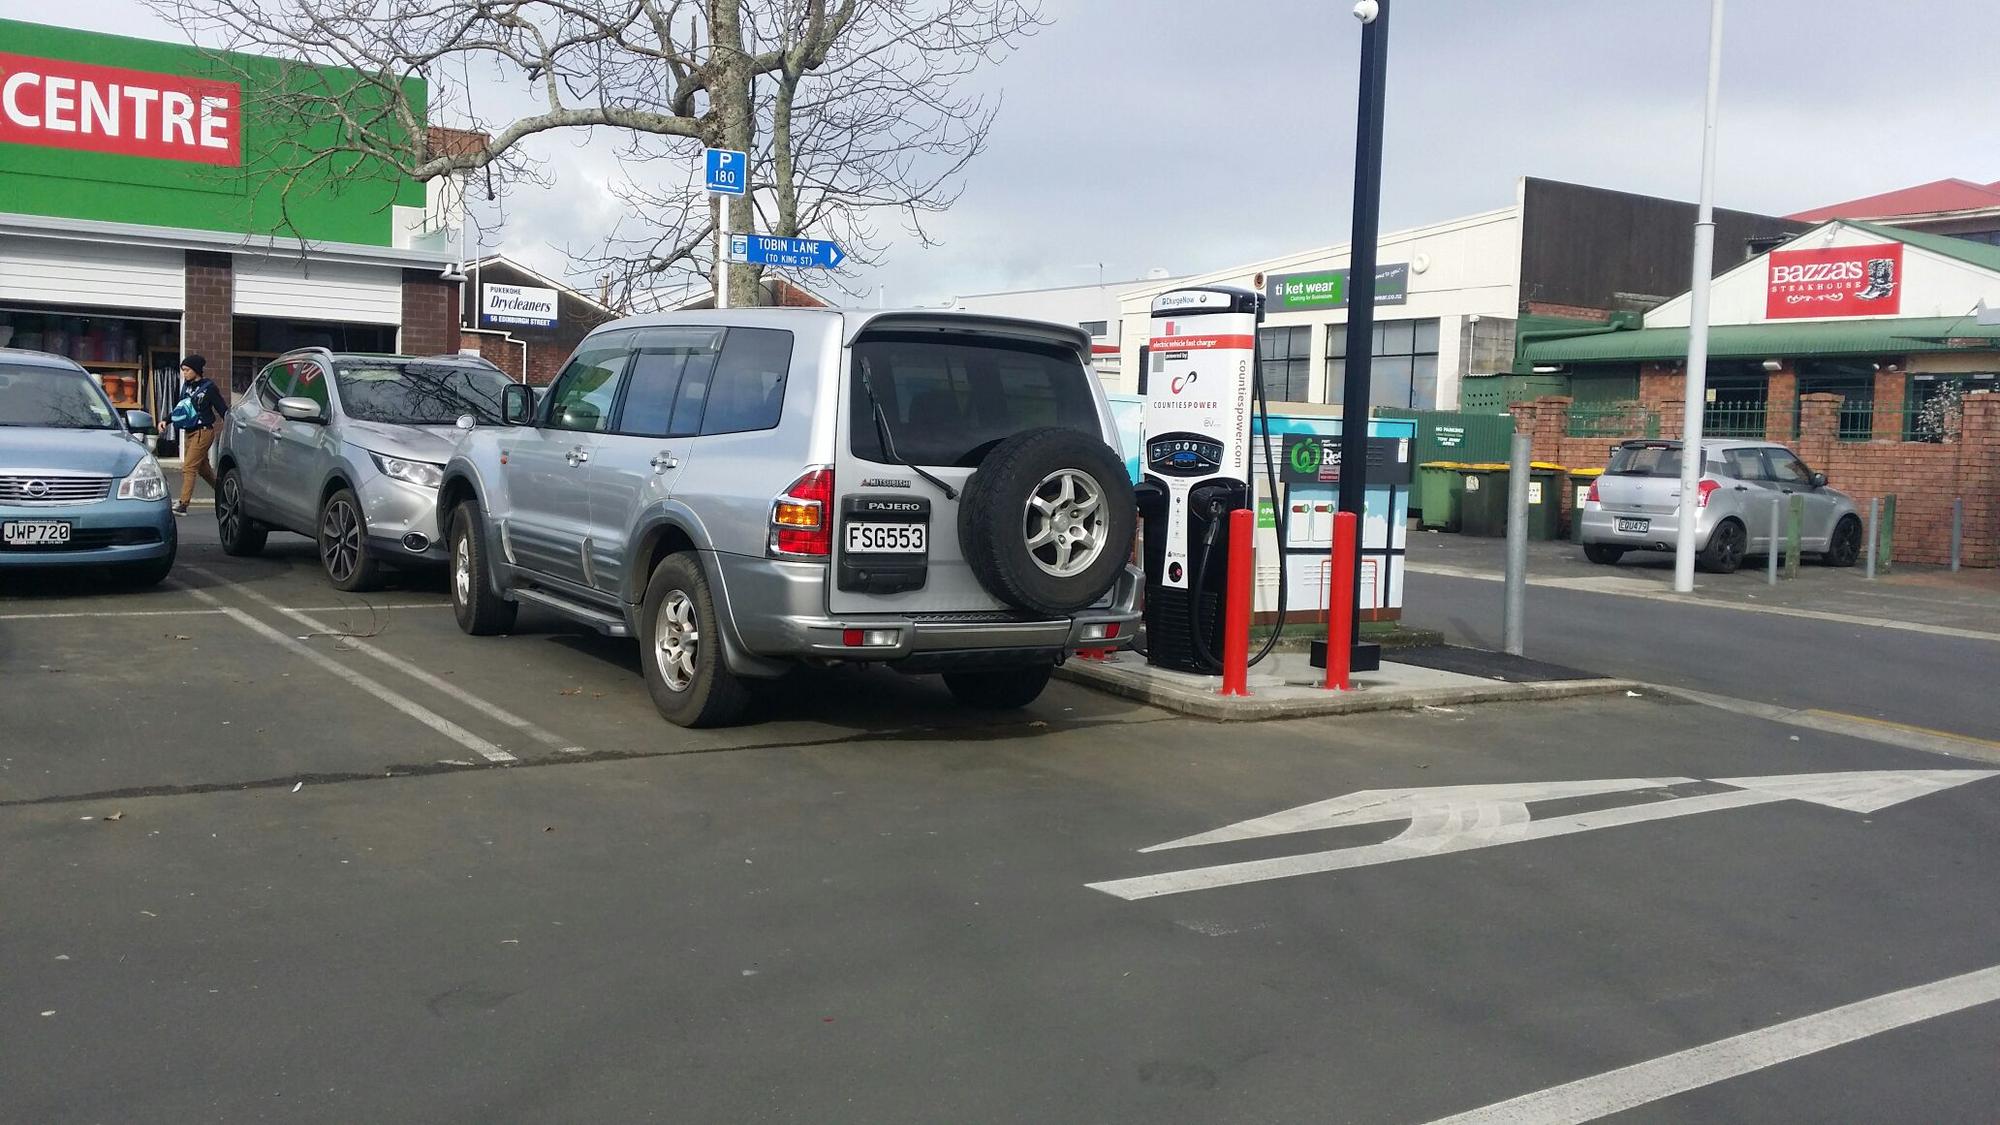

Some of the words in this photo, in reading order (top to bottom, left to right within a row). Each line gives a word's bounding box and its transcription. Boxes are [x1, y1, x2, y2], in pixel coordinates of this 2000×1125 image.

[2, 71, 229, 149] CENTRE
[720, 152, 732, 168] P
[715, 170, 735, 183] 180
[758, 238, 788, 252] TOBIN
[792, 240, 820, 254] LANE
[765, 253, 779, 263] (TO
[781, 255, 798, 265] KING
[800, 256, 813, 266] ST)
[490, 286, 521, 295] PUKEKOHE
[1306, 281, 1334, 293] wear
[1771, 282, 1862, 292] STEAKHOUSE
[490, 295, 552, 312] Drycleaners
[498, 316, 530, 325] EDINBURGH
[530, 318, 551, 326] STREET
[1153, 340, 1170, 348] electric
[1196, 339, 1217, 347] charger
[1234, 359, 1248, 468] countiespower.com
[869, 478, 912, 489] MITSUBISHI
[868, 502, 920, 511] PAJERO
[5, 524, 69, 540] JWP720
[849, 527, 923, 549] FSG553
